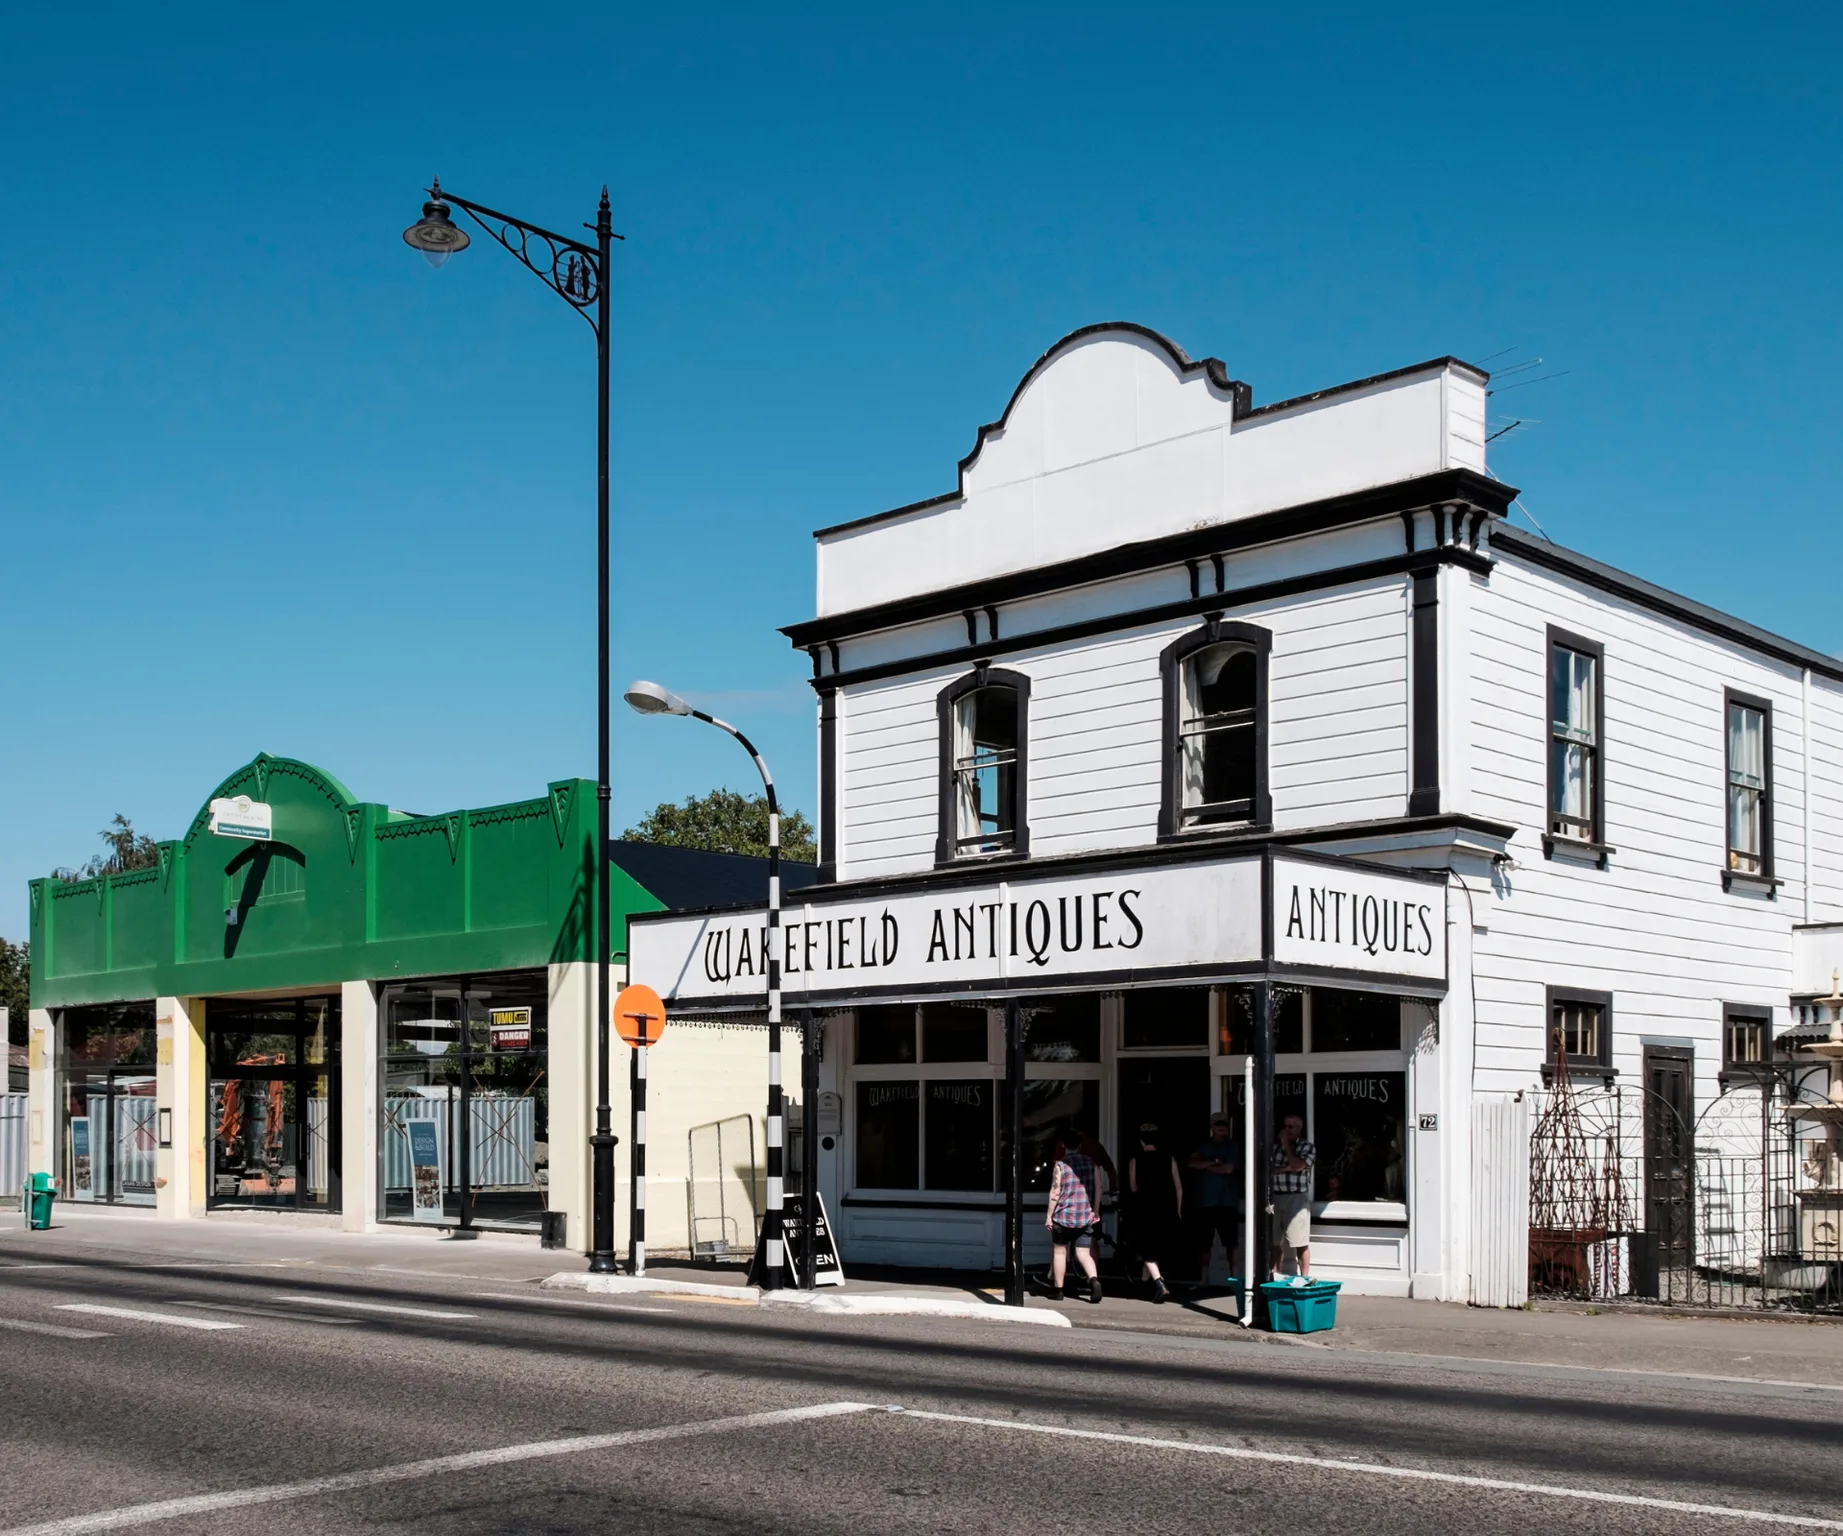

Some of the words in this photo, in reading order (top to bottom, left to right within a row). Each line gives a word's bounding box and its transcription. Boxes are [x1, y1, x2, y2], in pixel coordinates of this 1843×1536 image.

[1286, 884, 1432, 956] ANTIQUES
[705, 907, 899, 987] WAKEFIELD
[926, 889, 1144, 967] ANTIQUES
[493, 1012, 513, 1025] TUMU
[499, 1031, 529, 1041] DANGER
[933, 1085, 981, 1107] ANTIQUES
[1324, 1078, 1389, 1103] ANTIQUES
[1421, 1116, 1435, 1128] 72
[414, 1136, 434, 1145] DESIGN
